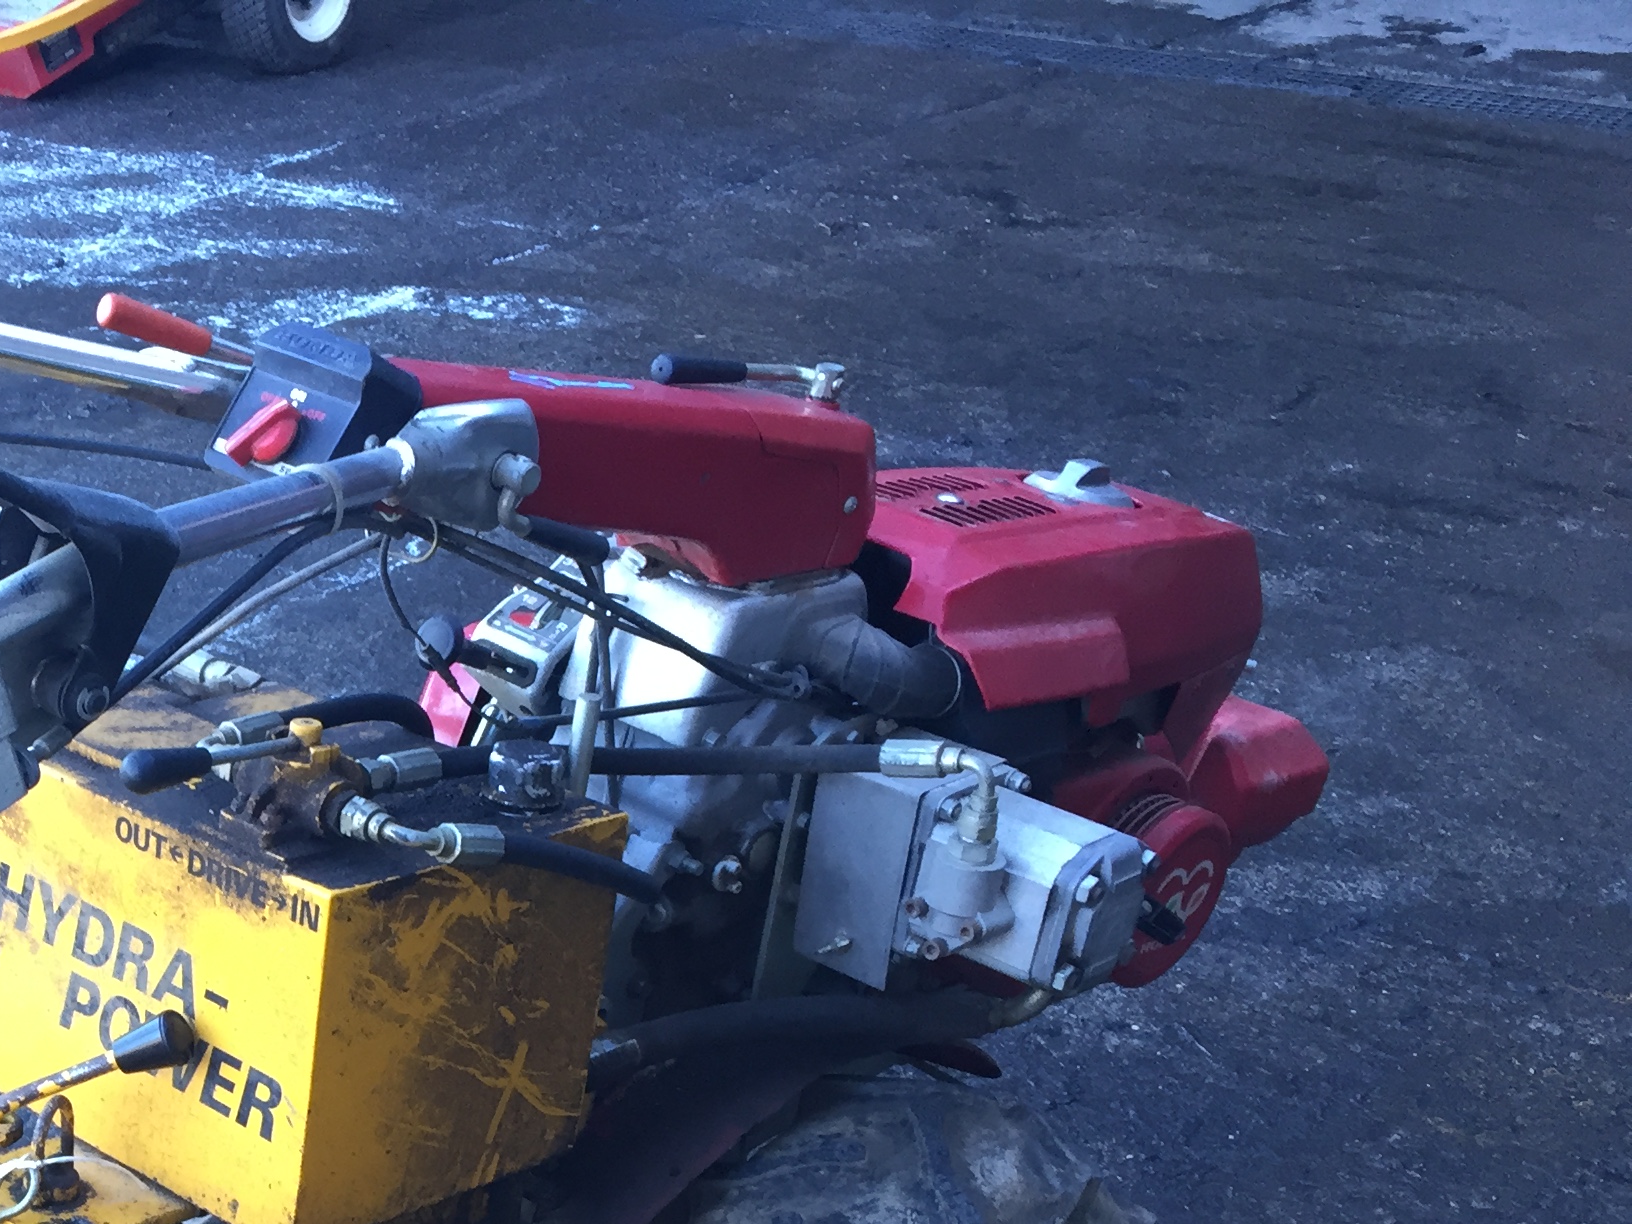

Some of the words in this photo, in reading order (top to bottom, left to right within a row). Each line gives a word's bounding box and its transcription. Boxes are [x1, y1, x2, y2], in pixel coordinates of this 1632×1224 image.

[114, 815, 169, 860] OUT
[186, 847, 269, 910] DRIVE
[290, 894, 321, 933] IN
